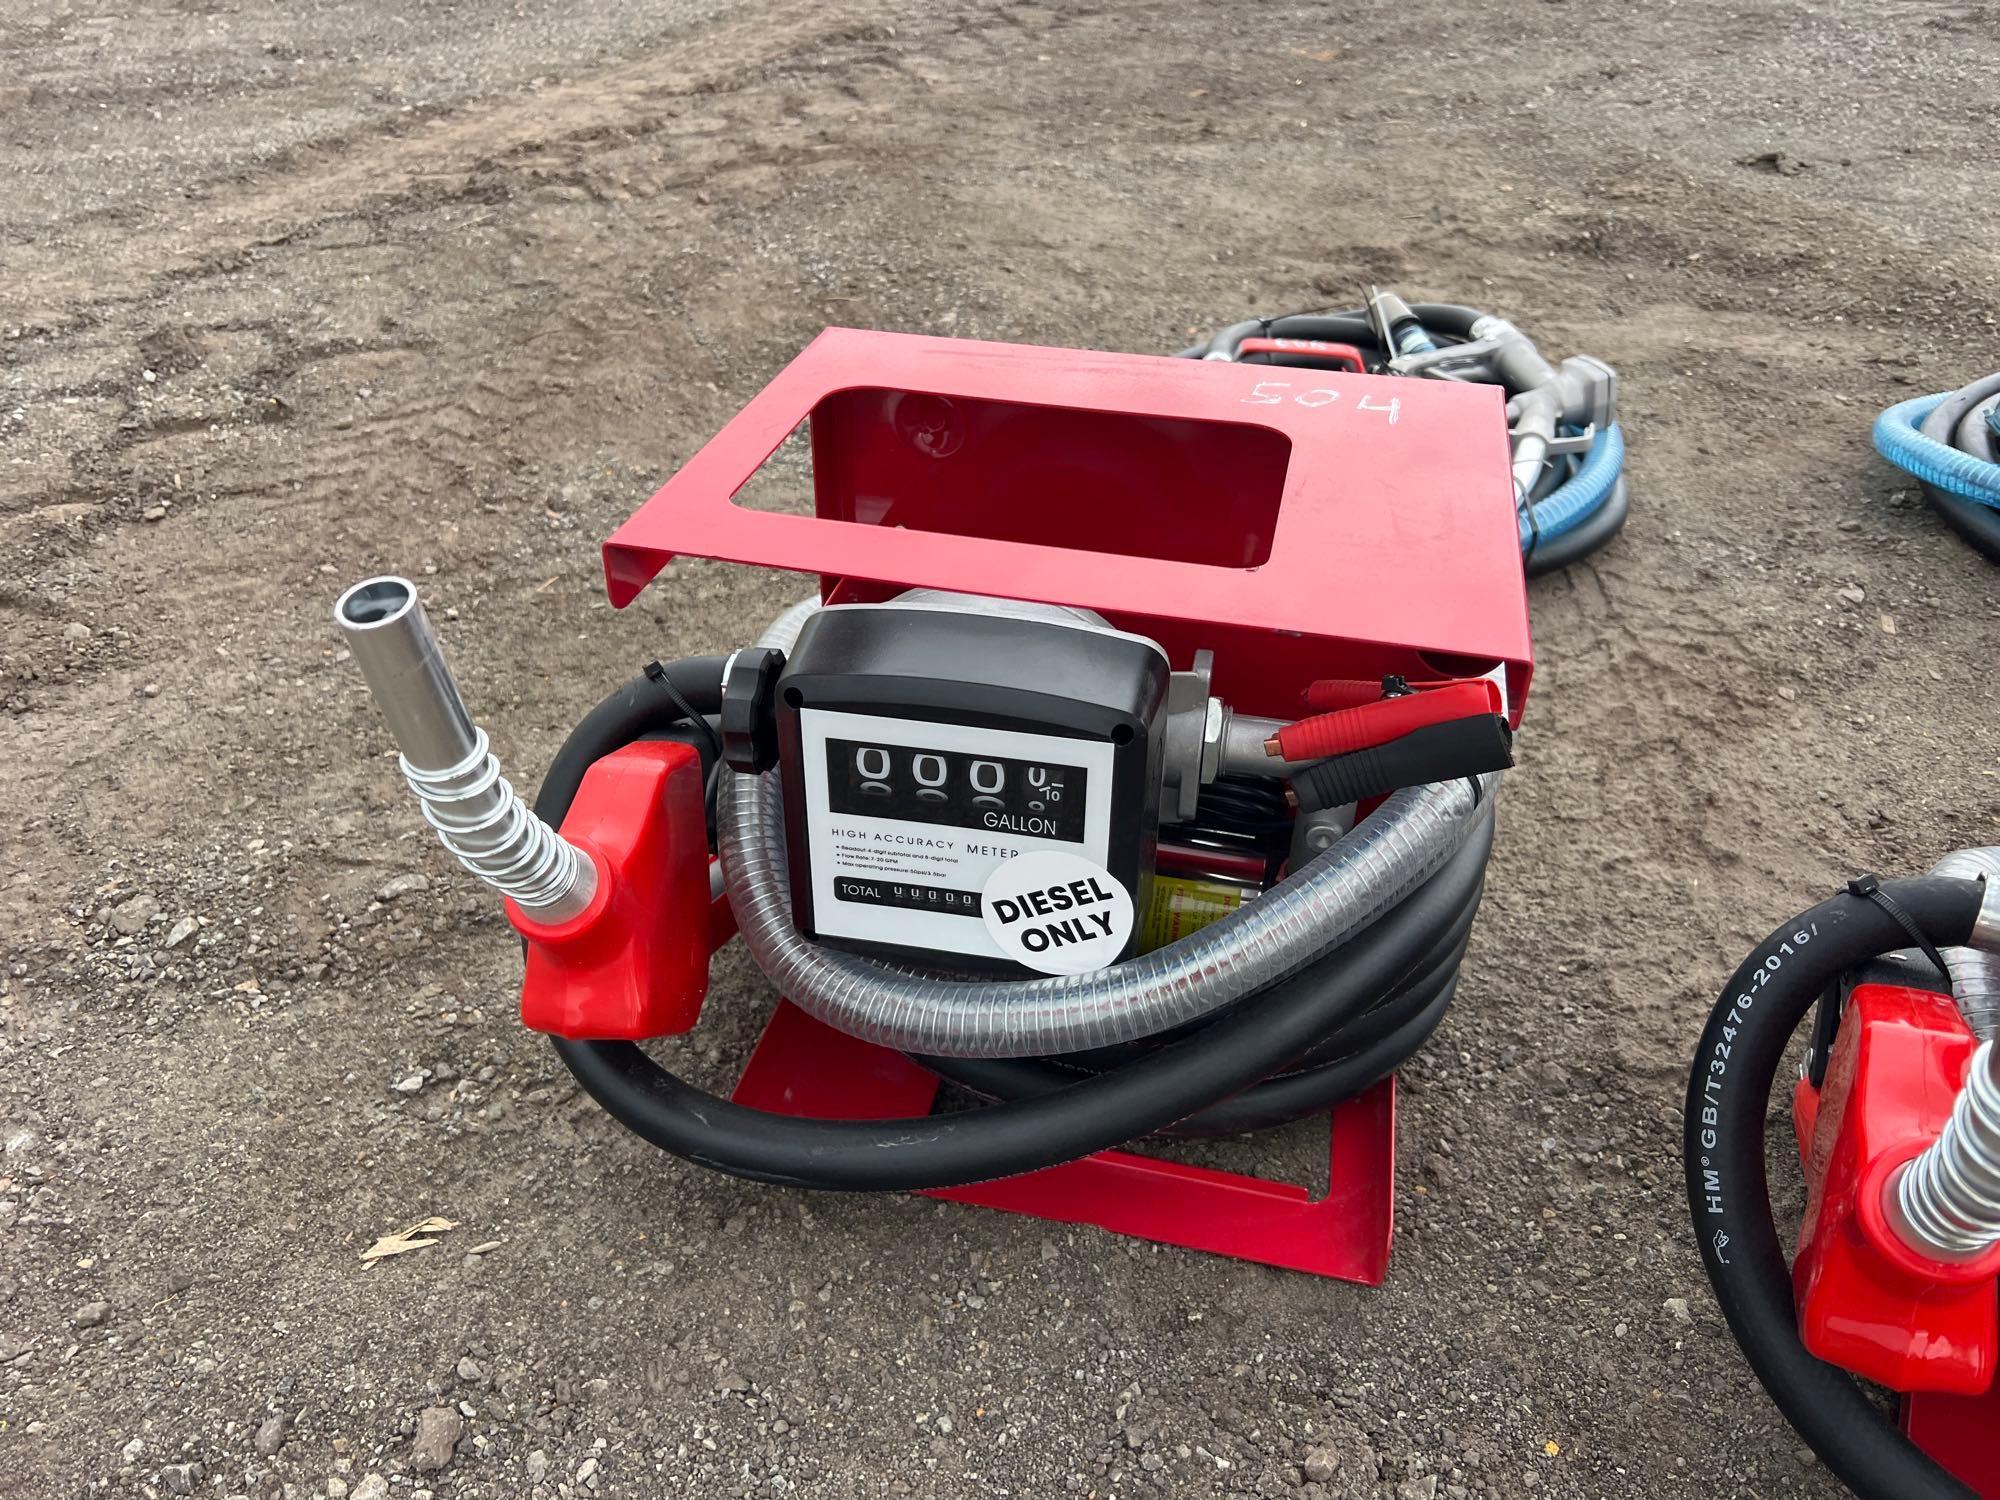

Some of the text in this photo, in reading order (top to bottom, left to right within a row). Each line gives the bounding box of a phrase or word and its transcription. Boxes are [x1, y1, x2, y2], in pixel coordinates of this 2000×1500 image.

[1240, 382, 1400, 424] 504
[984, 812, 1056, 835] GALLON
[831, 828, 866, 839] HIGH
[874, 833, 954, 849] ACCURACY
[855, 863, 883, 871] operating
[841, 883, 881, 898] TOTAL
[991, 877, 1114, 924] DIESEL
[1021, 910, 1113, 952] ONLY
